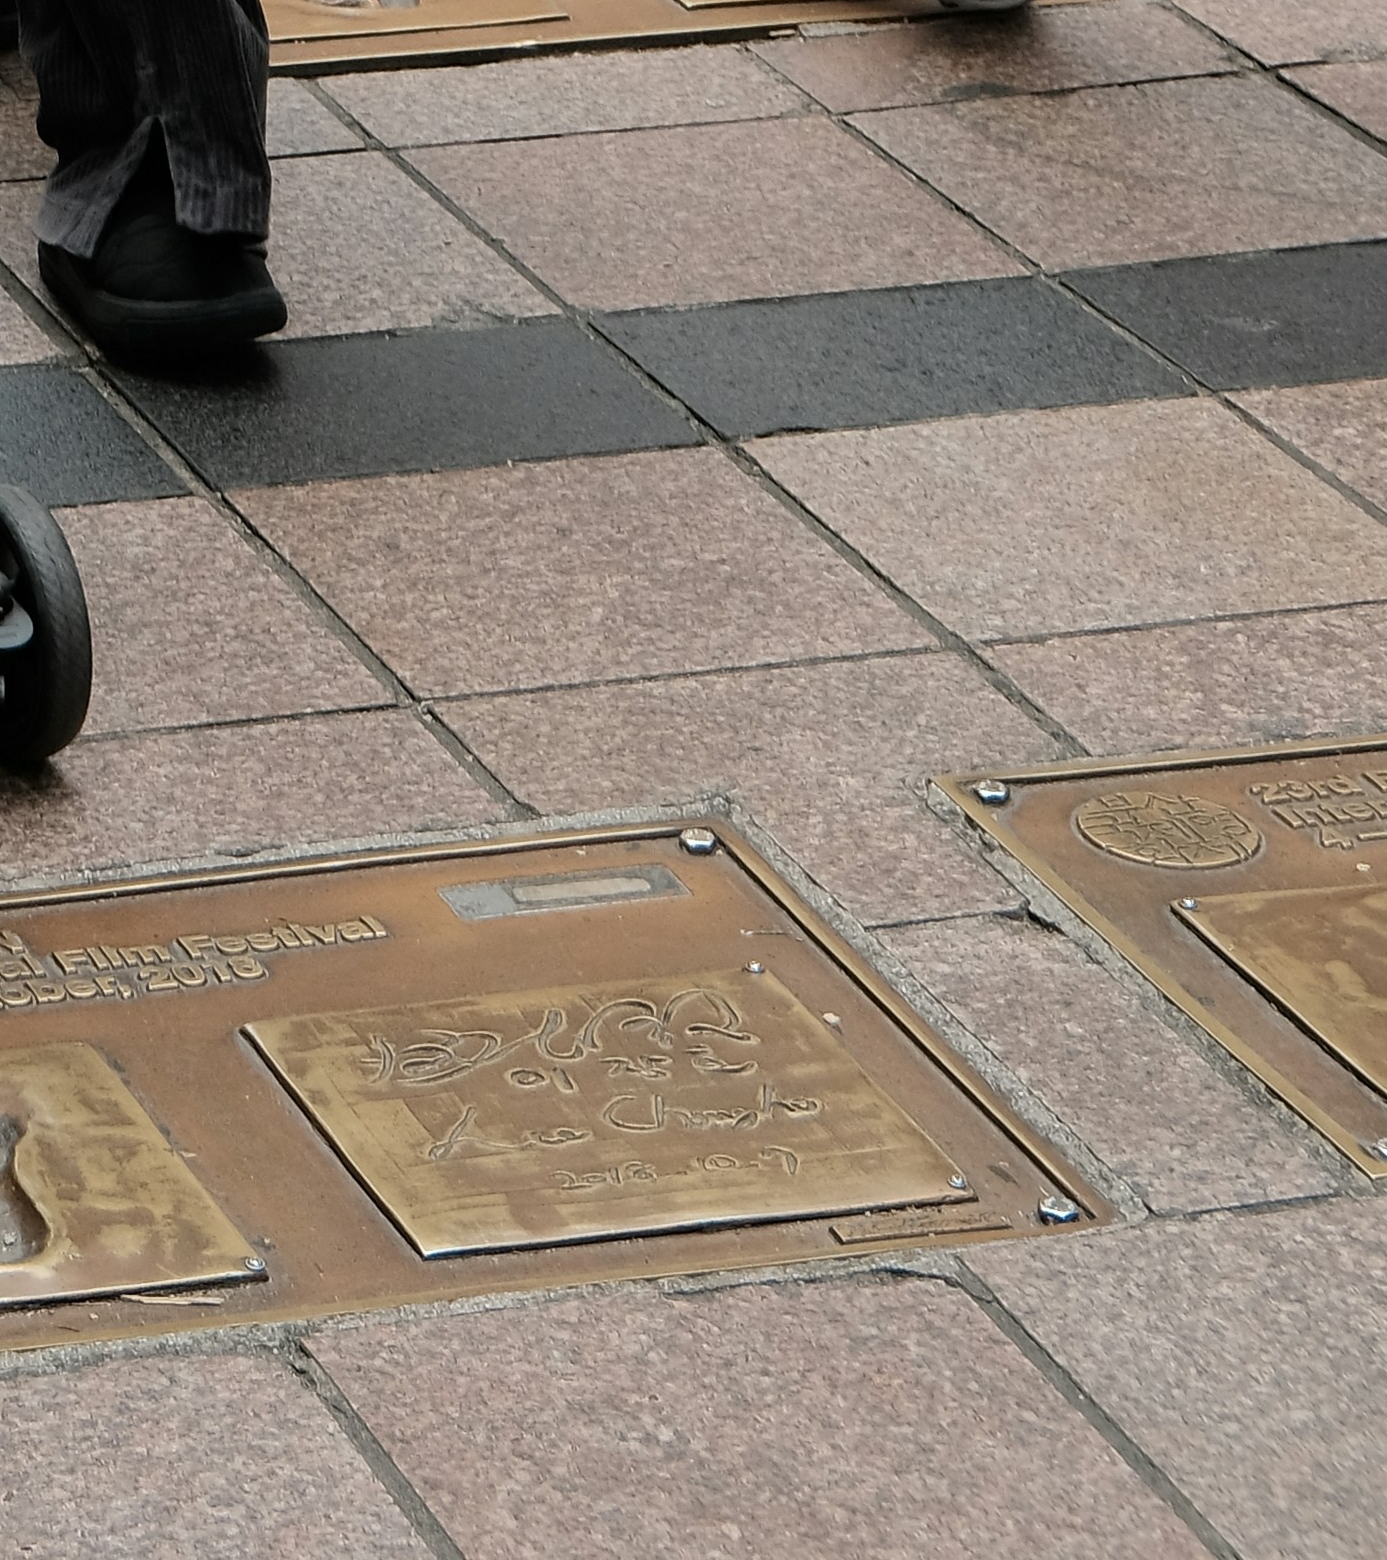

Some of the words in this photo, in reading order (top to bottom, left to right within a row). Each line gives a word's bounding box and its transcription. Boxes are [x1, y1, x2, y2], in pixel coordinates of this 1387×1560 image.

[51, 944, 172, 976] Film
[174, 915, 389, 960] Festival
[138, 954, 269, 993] 2018
